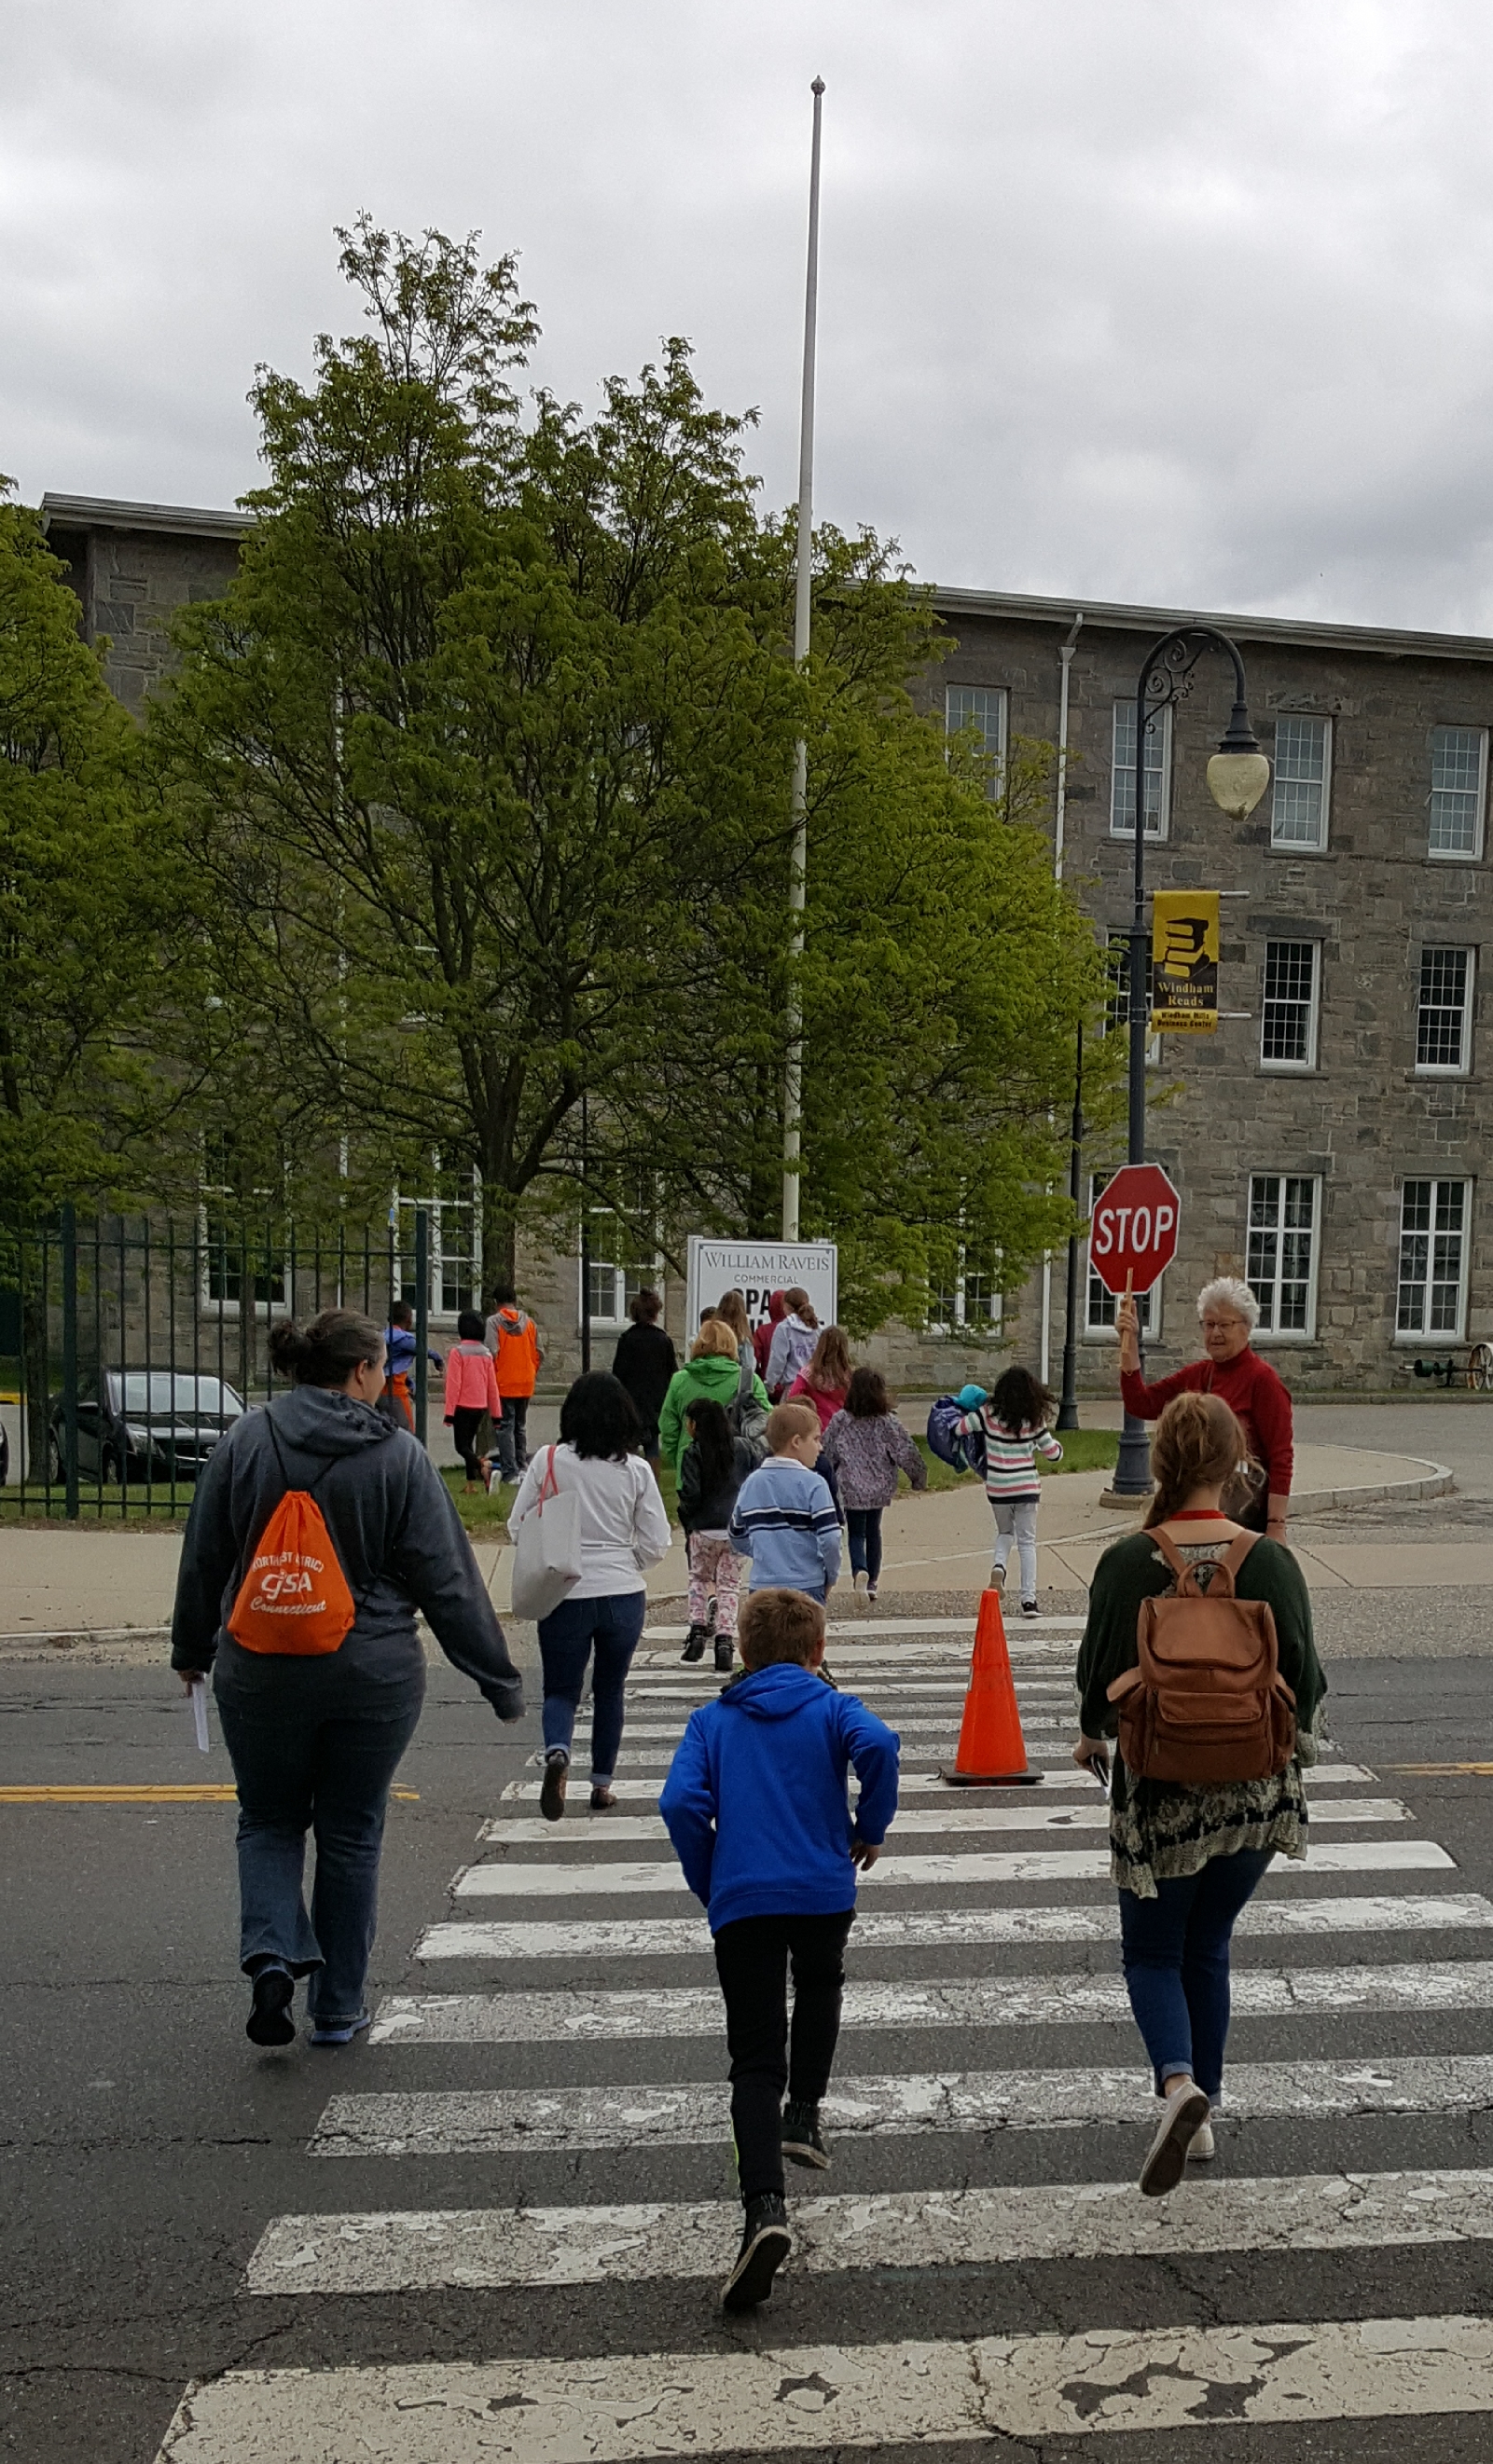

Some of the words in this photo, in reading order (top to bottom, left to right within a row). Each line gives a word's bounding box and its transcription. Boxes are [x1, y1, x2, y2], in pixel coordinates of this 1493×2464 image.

[1157, 982, 1214, 994] Windham
[1168, 995, 1204, 1006] Reads
[1096, 1205, 1174, 1254] STOP
[705, 1251, 775, 1270] WILLIAM
[778, 1254, 830, 1272] RAVEIS
[734, 1273, 799, 1285] COMMERCIAL
[250, 1595, 326, 1615] Connecticut
